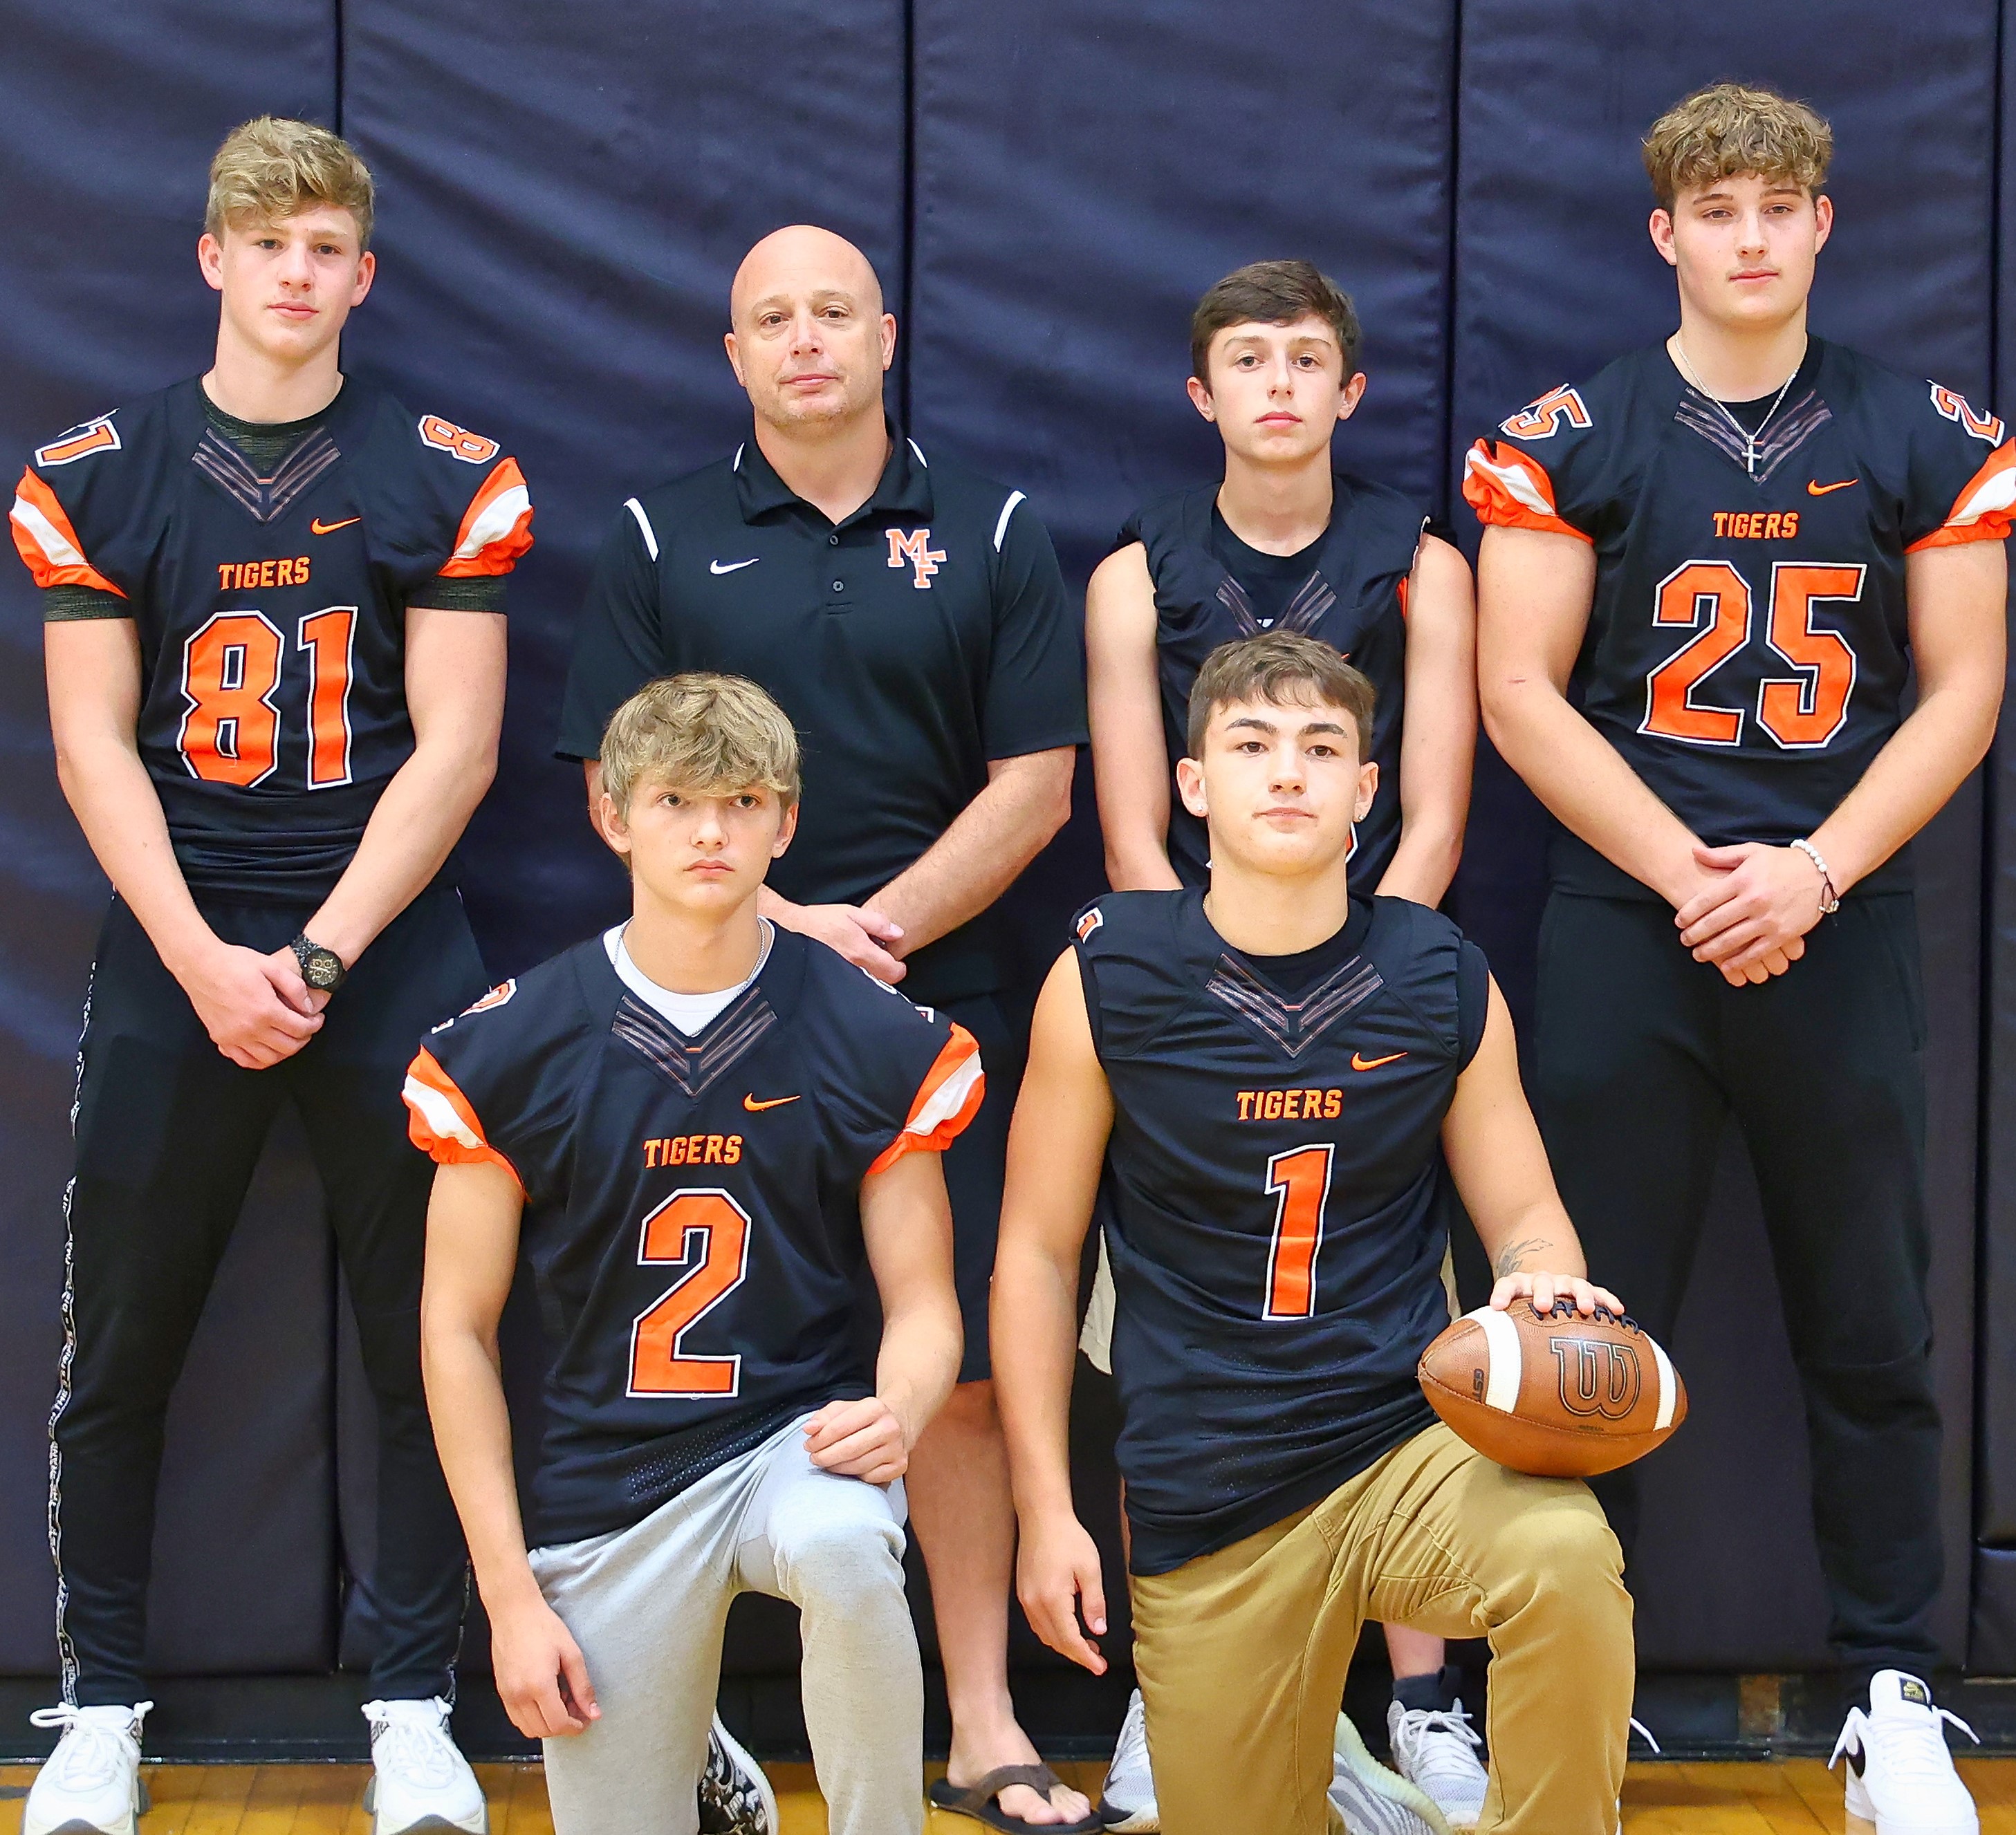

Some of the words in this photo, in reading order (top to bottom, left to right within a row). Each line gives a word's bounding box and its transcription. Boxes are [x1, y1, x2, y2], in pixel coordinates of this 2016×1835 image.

[217, 556, 311, 590] TIGERS
[1712, 512, 1800, 540] TIGERS
[176, 606, 359, 791] 81
[1636, 559, 1867, 749] 25
[642, 1134, 743, 1169] TIGERS
[1235, 1089, 1343, 1121] TIGERS
[1261, 1143, 1335, 1321] 1
[625, 1187, 752, 1400] 2
